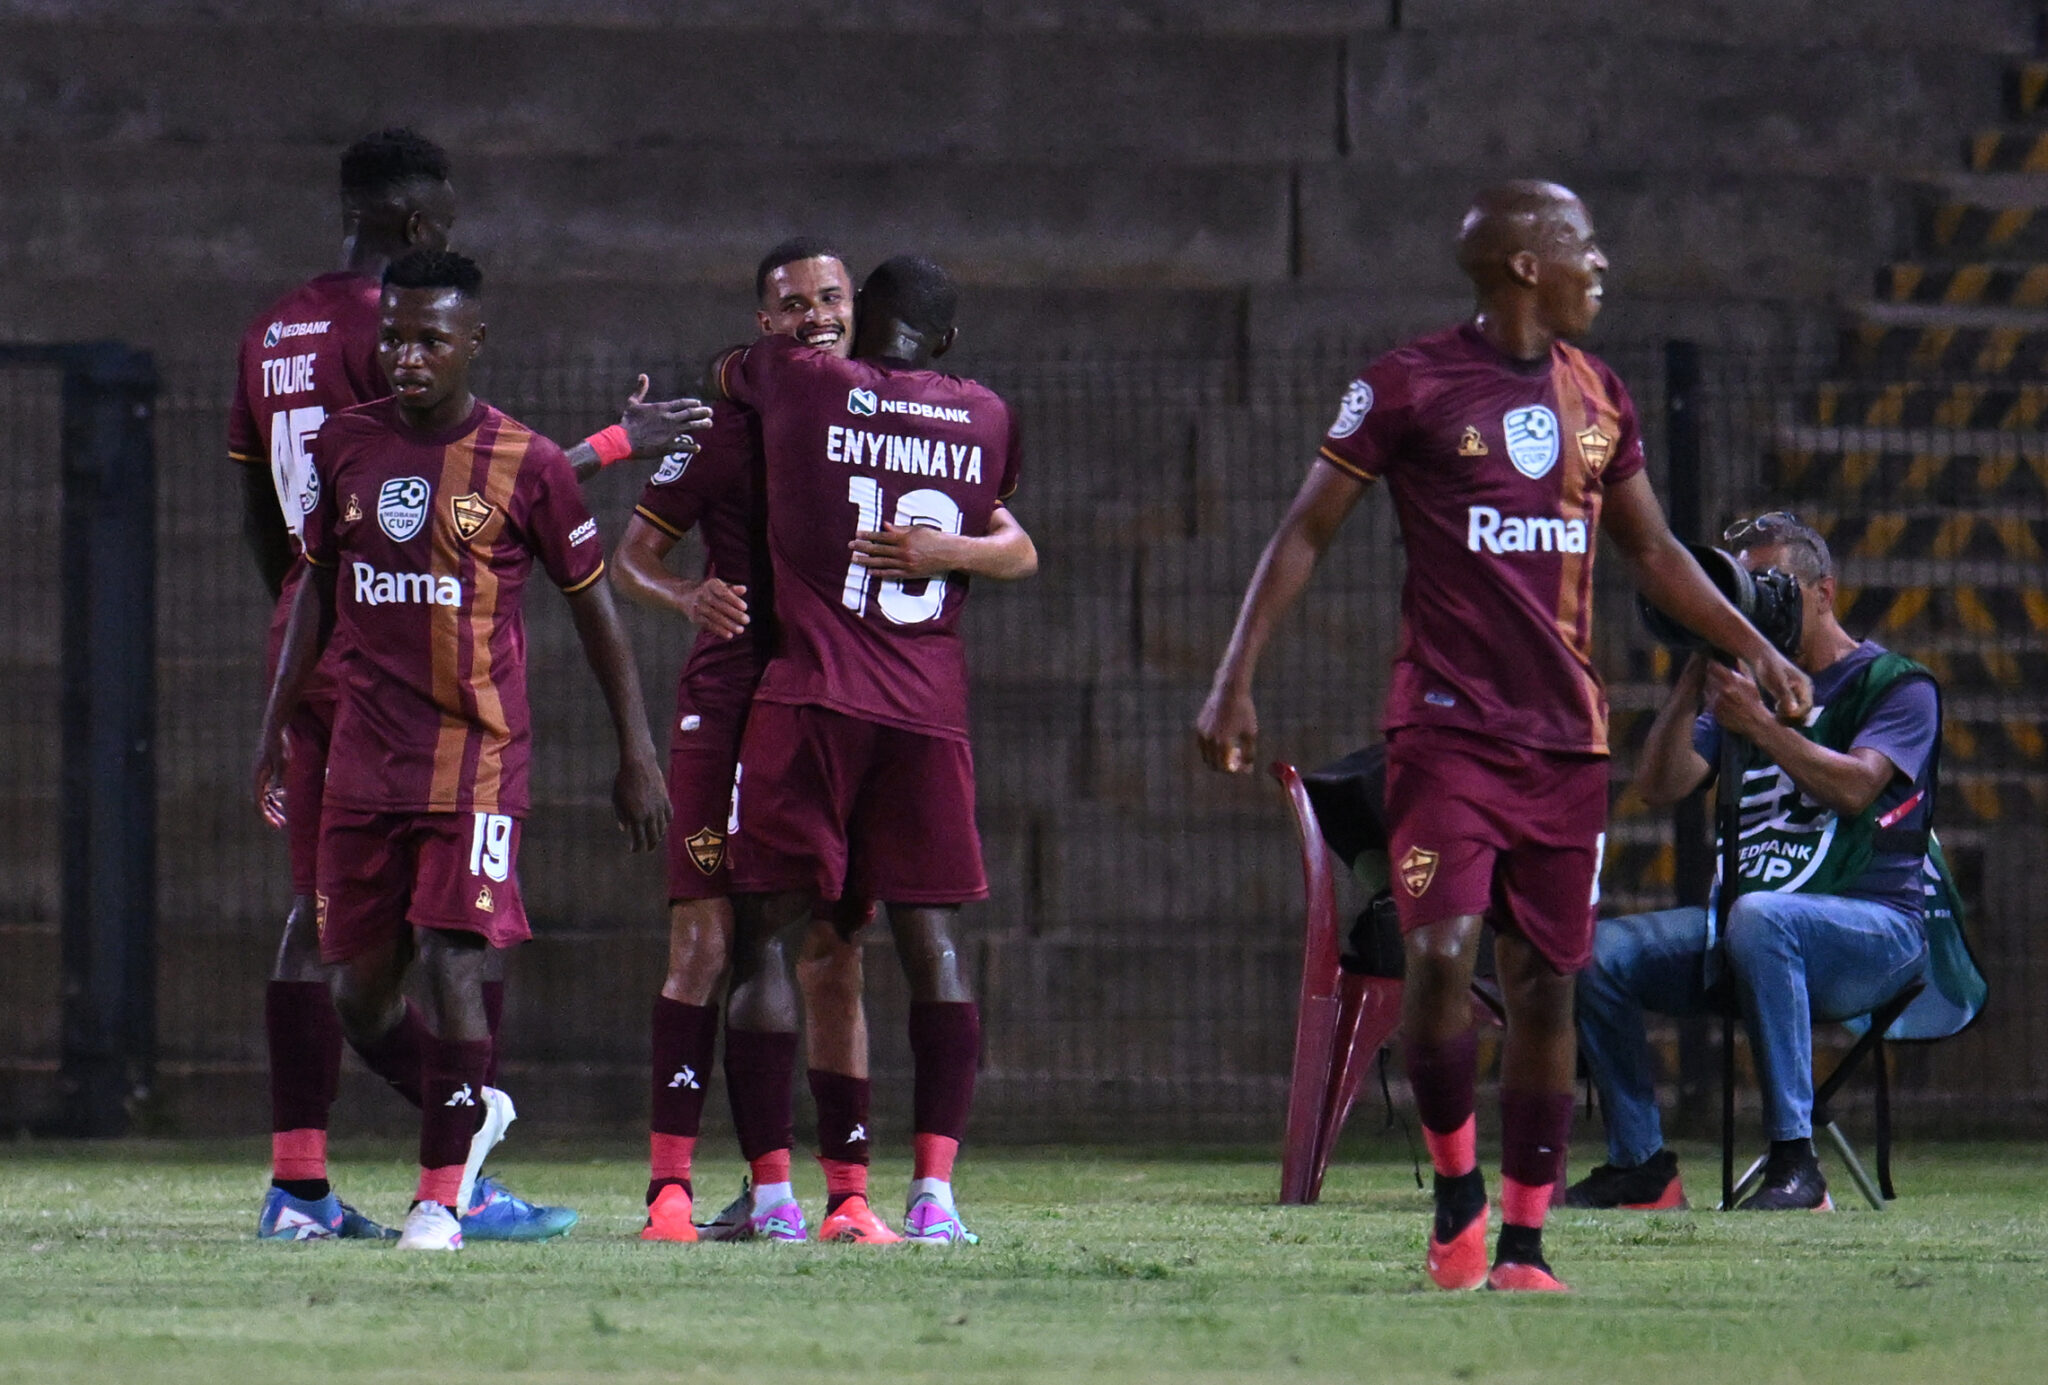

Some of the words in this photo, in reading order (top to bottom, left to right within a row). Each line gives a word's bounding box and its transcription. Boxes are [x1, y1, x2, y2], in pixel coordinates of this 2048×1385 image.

[281, 321, 331, 338] NEDBANK
[261, 353, 316, 398] TOURE
[880, 400, 971, 423] NEDBANK
[827, 425, 982, 484] ENYINNAYA
[389, 518, 414, 529] CUP
[1468, 506, 1587, 554] Rama
[352, 562, 462, 608] Rama
[469, 812, 513, 882] 19
